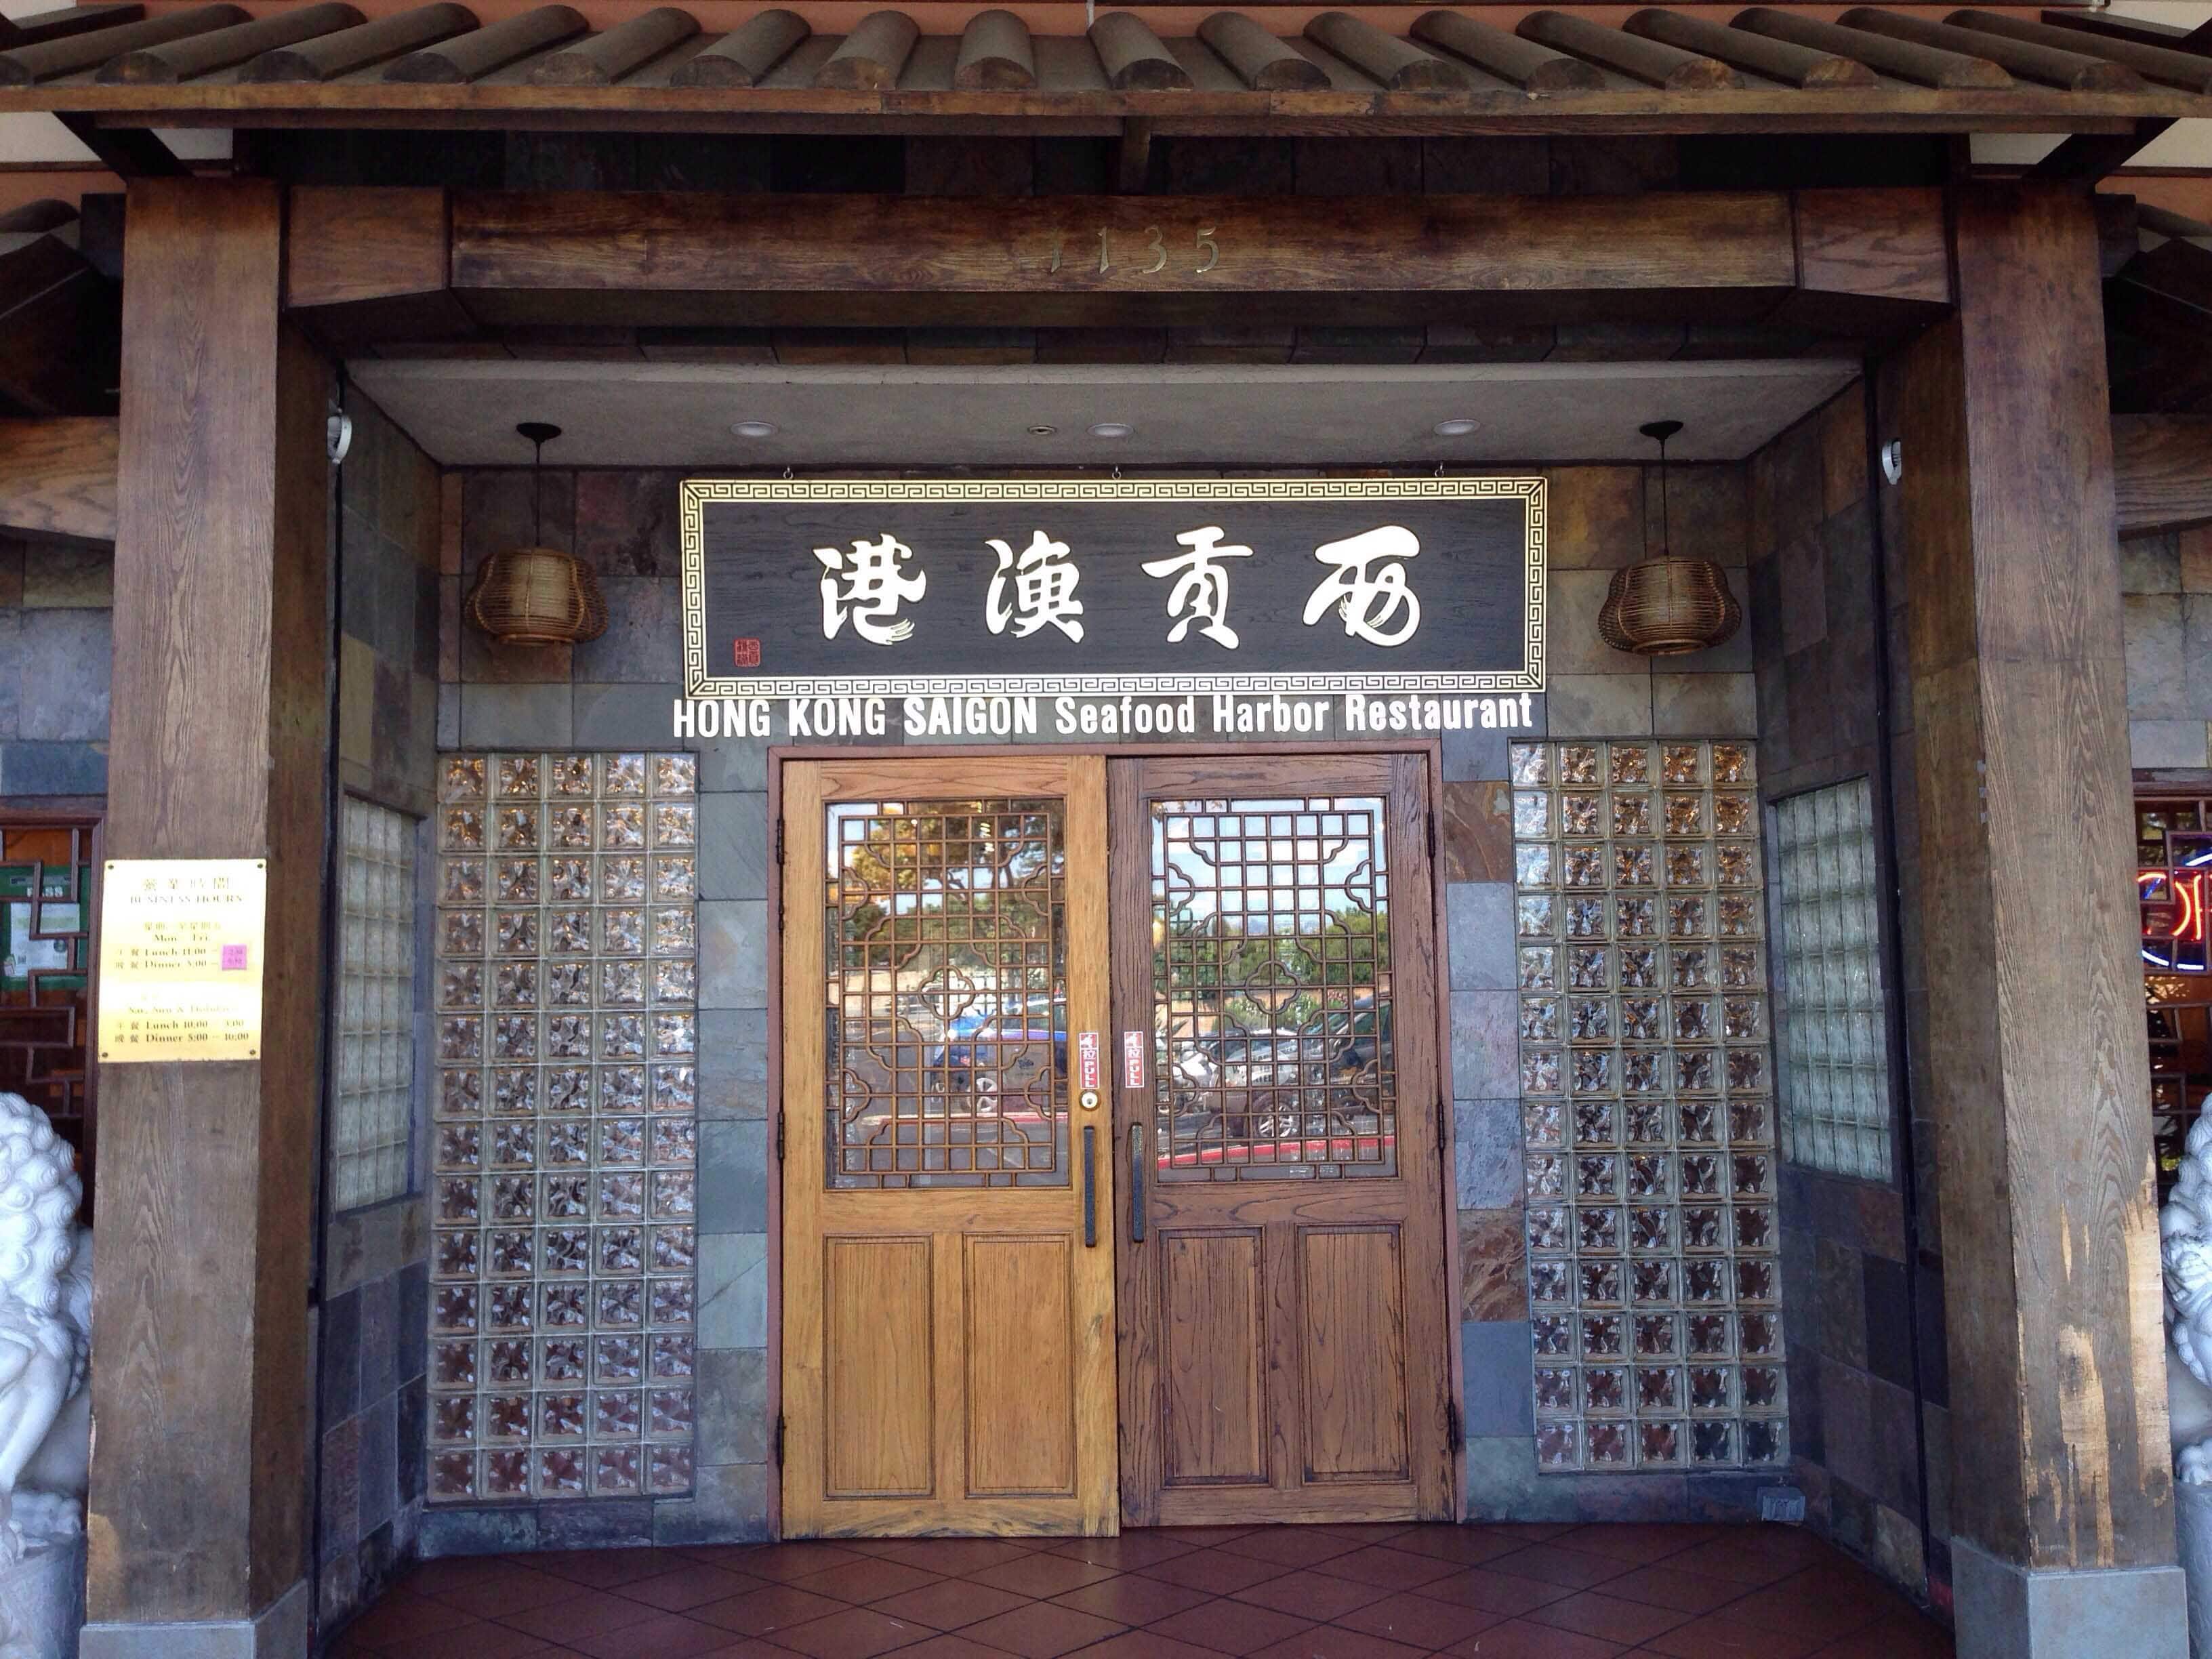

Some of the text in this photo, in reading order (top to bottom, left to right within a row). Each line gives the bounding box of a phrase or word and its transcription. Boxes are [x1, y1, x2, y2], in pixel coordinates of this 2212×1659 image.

[674, 693, 1533, 737] HONG KONG SAIGON Seafood Harbor Restaurant
[146, 1021, 178, 1029] Lunch
[146, 1033, 183, 1042] Dinner
[188, 1033, 208, 1042] 5:00
[224, 1032, 249, 1041] 10:00
